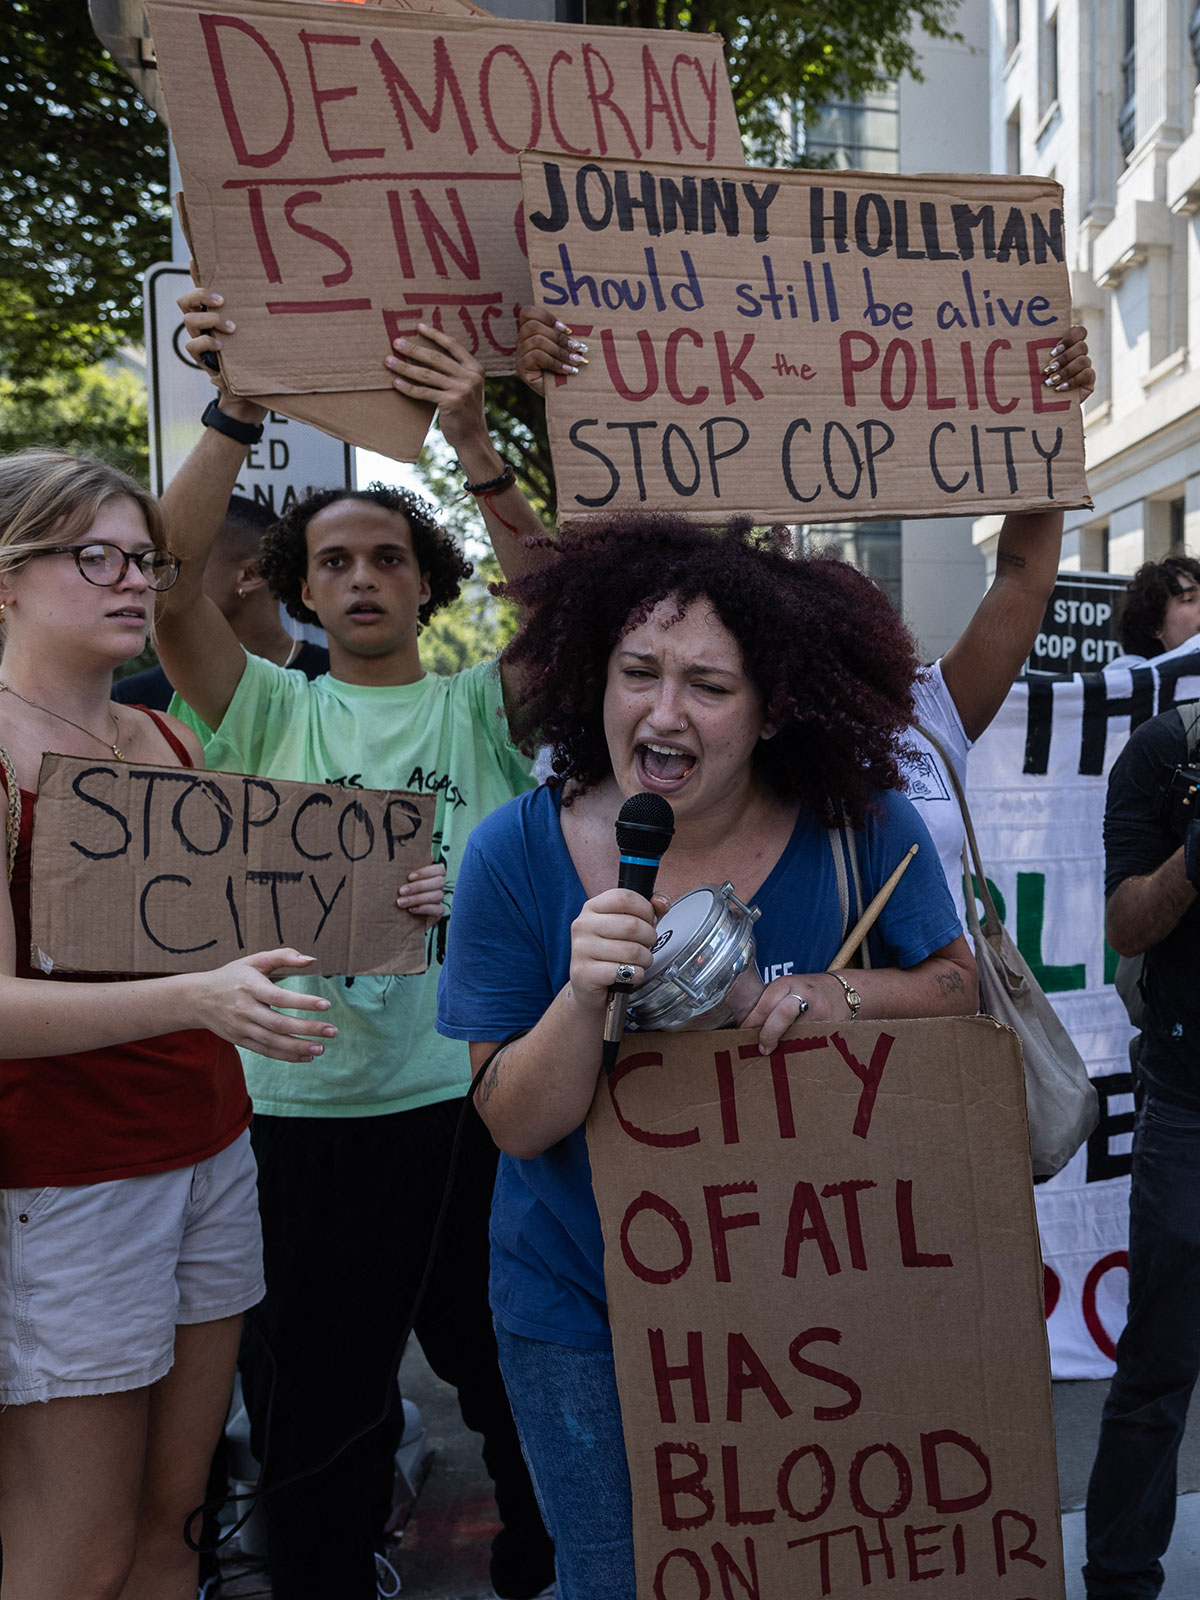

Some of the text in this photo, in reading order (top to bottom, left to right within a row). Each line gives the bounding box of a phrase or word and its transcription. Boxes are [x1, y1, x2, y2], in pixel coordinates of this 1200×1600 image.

[200, 13, 717, 168] DEMOCRACY
[247, 187, 354, 287] IS
[386, 187, 481, 280] IN
[530, 161, 780, 242] JOHNNY
[810, 187, 1065, 265] HOLLMAN
[381, 302, 522, 363] FUC
[539, 243, 1058, 331] should still be alive
[771, 352, 817, 380] the
[839, 330, 1072, 414] POLICE
[569, 416, 1064, 508] STOP COP CITY
[1034, 632, 1077, 660] COP
[1053, 598, 1112, 627] STOP
[70, 766, 422, 861] STOP COP
[140, 870, 347, 954] CITY
[608, 1031, 896, 1149] CITY
[619, 1179, 954, 1284] OF ATL
[647, 1326, 862, 1424] HAS
[654, 1429, 992, 1532] BLOOD
[652, 1509, 1047, 1600] ON THEIR
